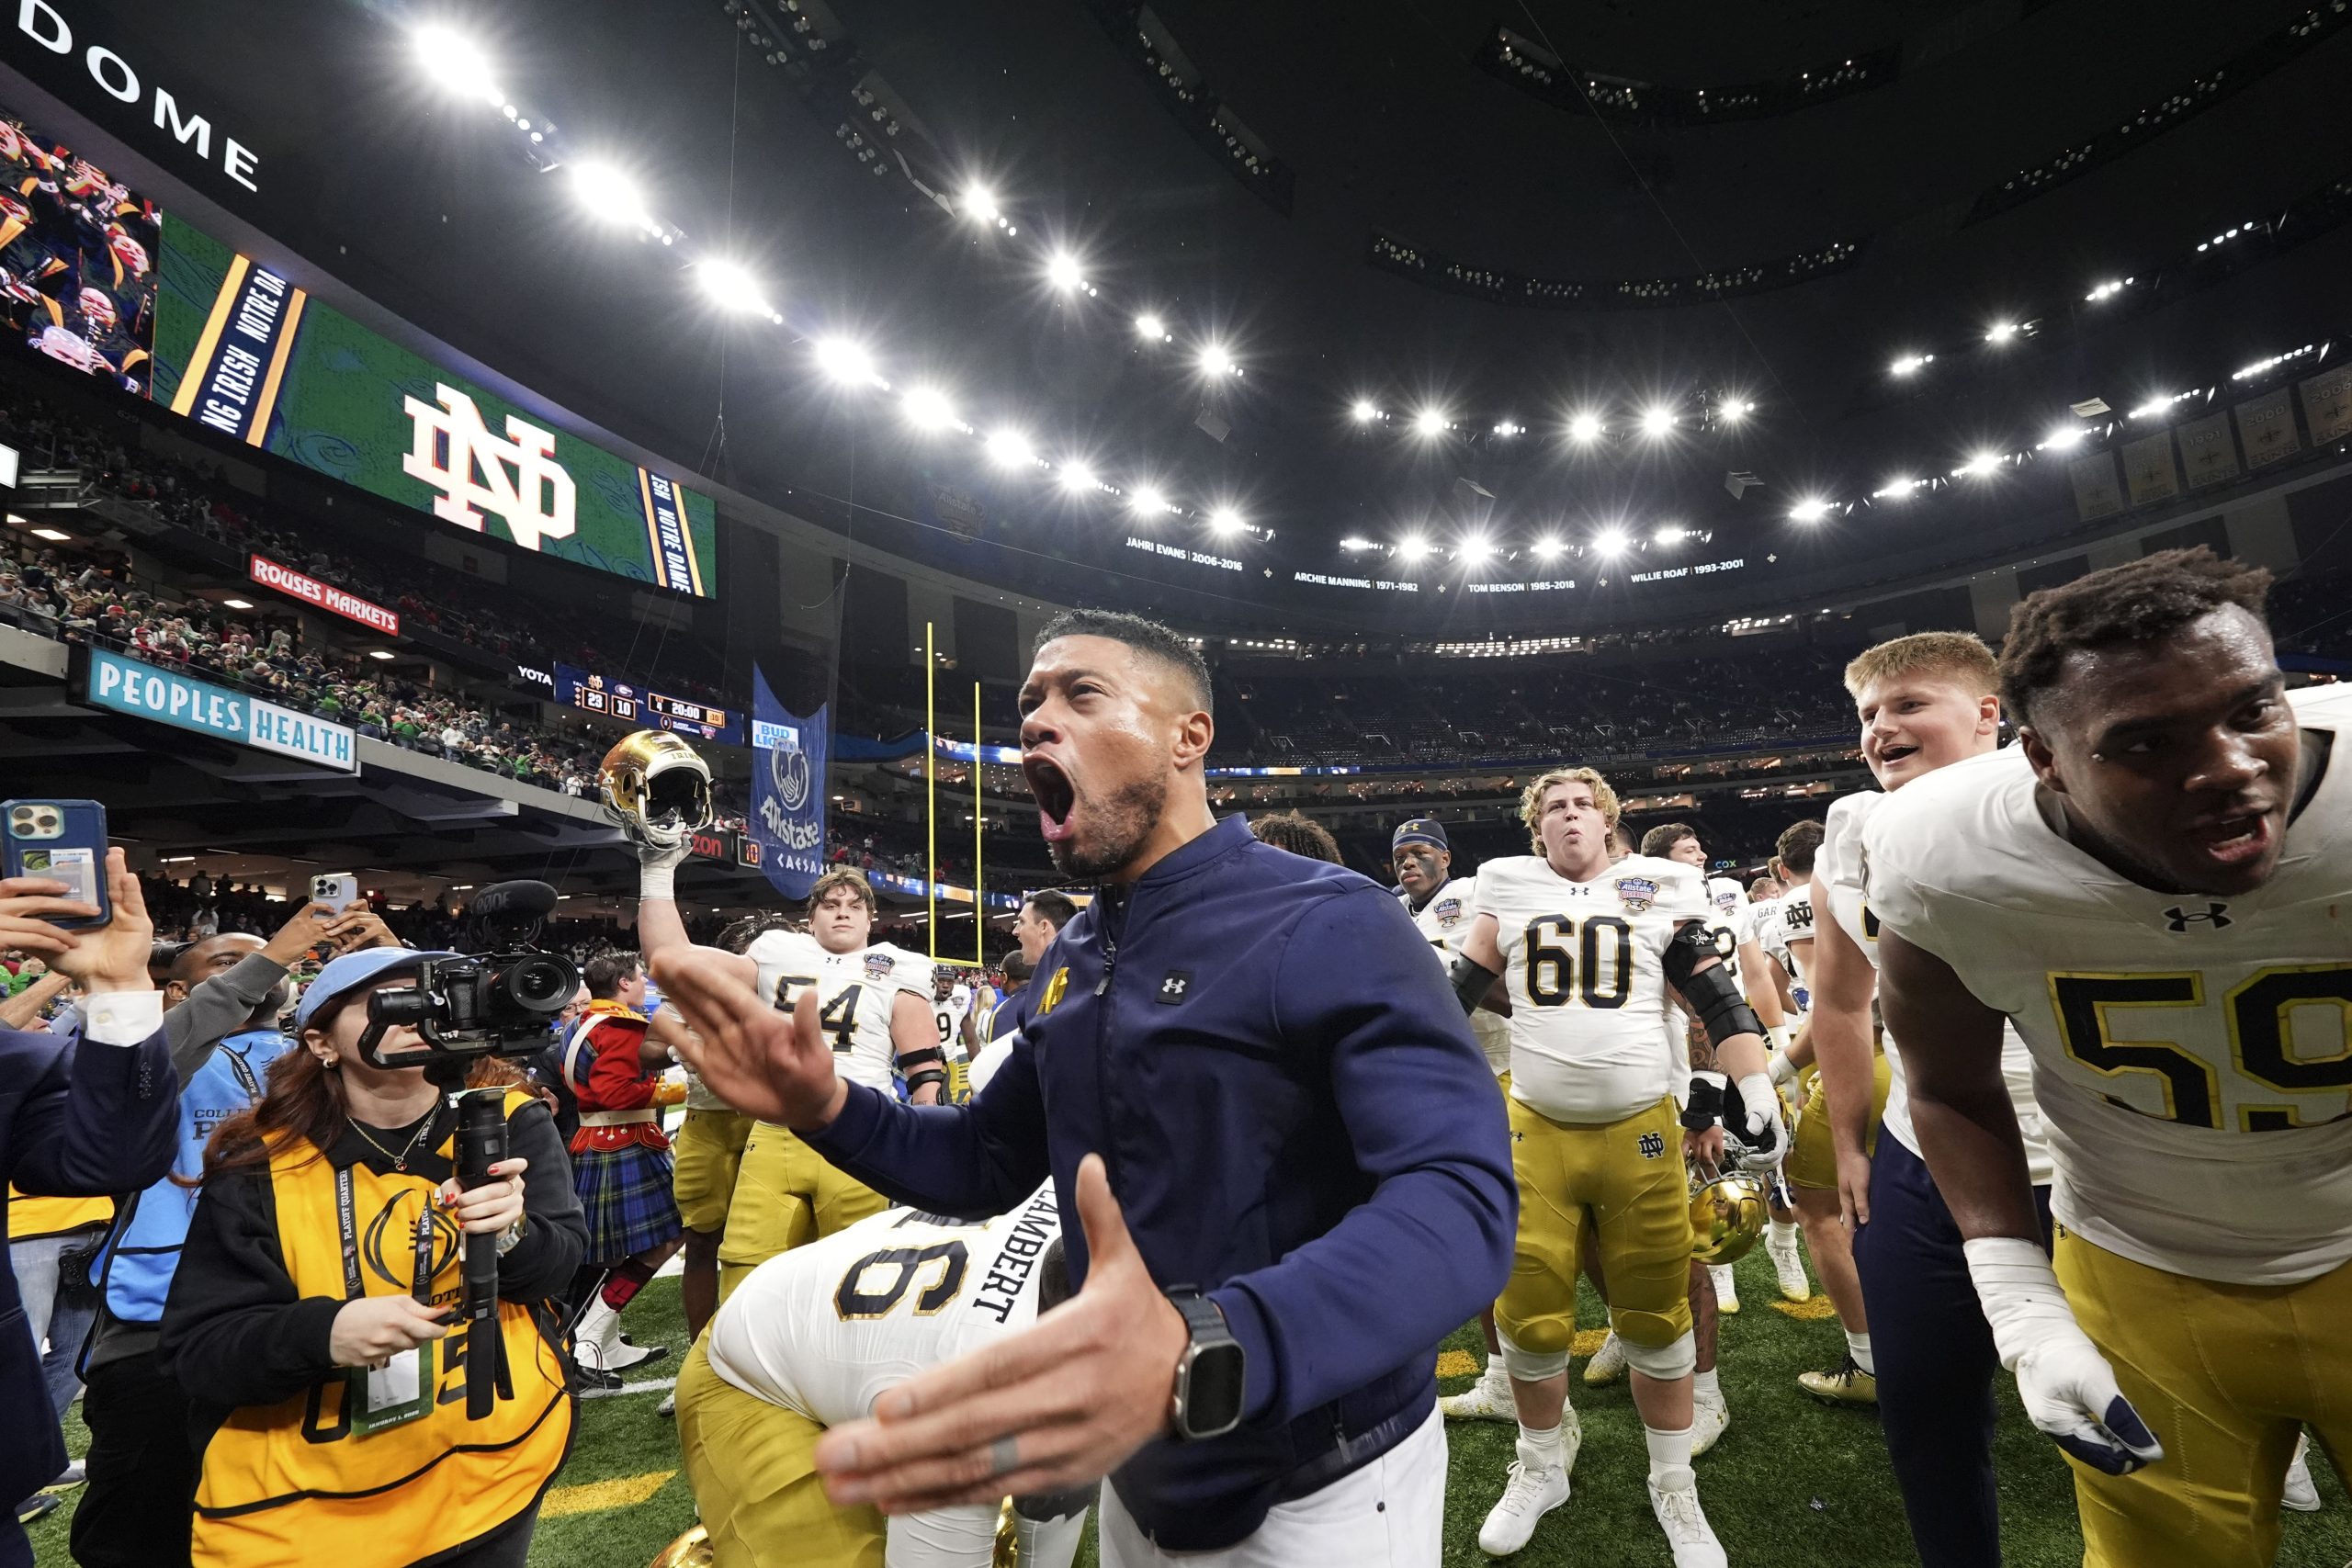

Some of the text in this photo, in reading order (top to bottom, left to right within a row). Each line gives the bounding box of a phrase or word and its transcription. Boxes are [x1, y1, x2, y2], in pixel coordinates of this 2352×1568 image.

[18, 0, 258, 192] DOME
[235, 287, 280, 344] NOTRE
[211, 344, 261, 406] IRISH
[657, 506, 683, 552] NOTRE
[1125, 536, 1243, 571] JAHRI EVANS 2006-2016
[1631, 558, 1744, 583] WILLIE ROAF 1993-2001
[665, 550, 692, 594] DAME
[1295, 571, 1419, 592] ARCHIE MANNING 1971-1982
[1468, 580, 1576, 593] TOM BENSON 1985-2018
[254, 558, 396, 631] ROUSES MARKETS
[517, 665, 553, 686] YOTA
[98, 660, 349, 761] PEOPLES HEALTH
[587, 692, 604, 708] 23
[616, 699, 631, 716] 10
[656, 702, 700, 720] 4 20:00
[761, 724, 790, 739] BUD
[760, 795, 821, 851] Allstate
[745, 842, 759, 864] 10
[776, 852, 831, 875] CAESARS
[1714, 859, 1737, 869] COX
[1622, 884, 1652, 893] Allstate
[1524, 912, 1634, 1010] 60
[2046, 963, 2352, 1133] 59
[341, 1206, 353, 1241] PLAYOFF
[972, 1189, 1059, 1325] LAMBERT
